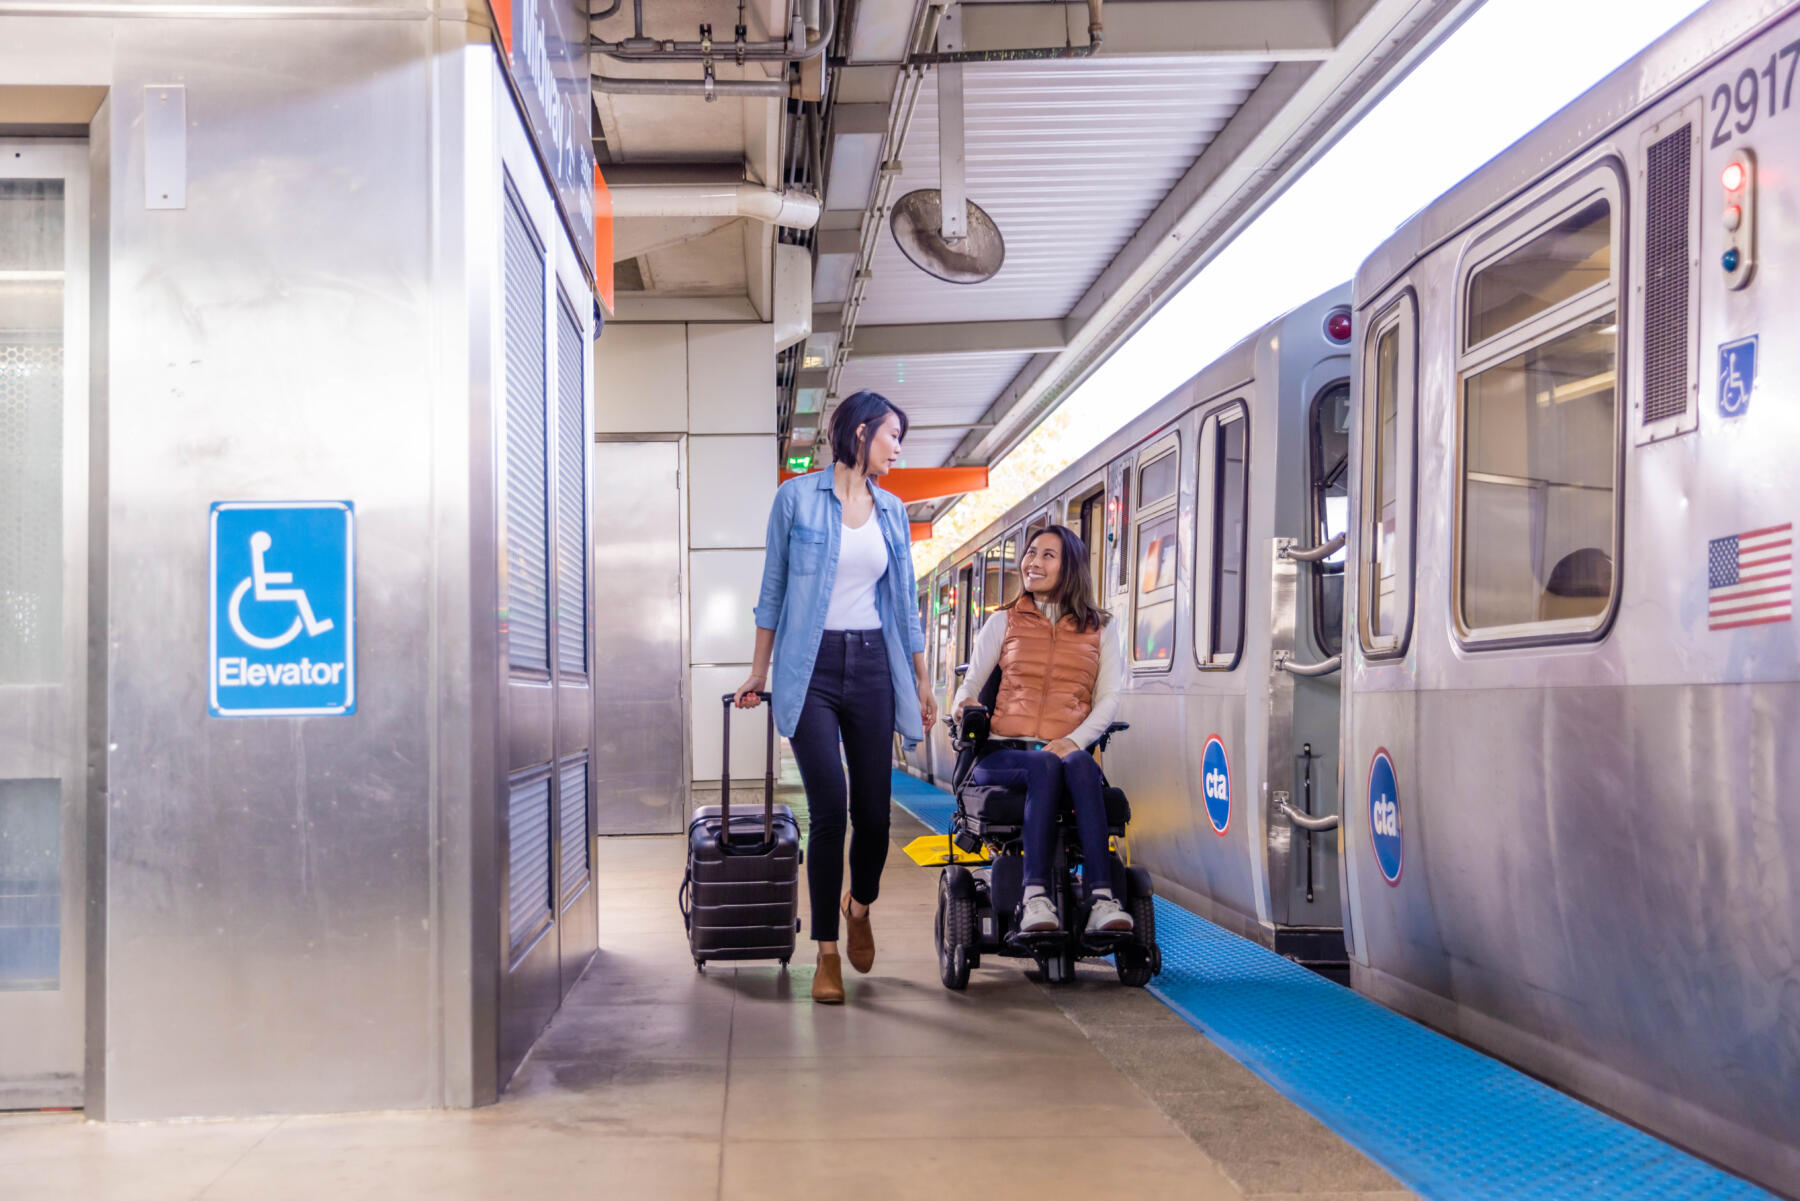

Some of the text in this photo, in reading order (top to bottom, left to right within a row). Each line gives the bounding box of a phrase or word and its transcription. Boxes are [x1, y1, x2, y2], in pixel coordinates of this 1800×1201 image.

[522, 0, 564, 178] Midway
[1710, 39, 1800, 150] 2917
[218, 657, 344, 687] Elevator
[1206, 768, 1227, 801] cta
[1373, 793, 1397, 837] cta
